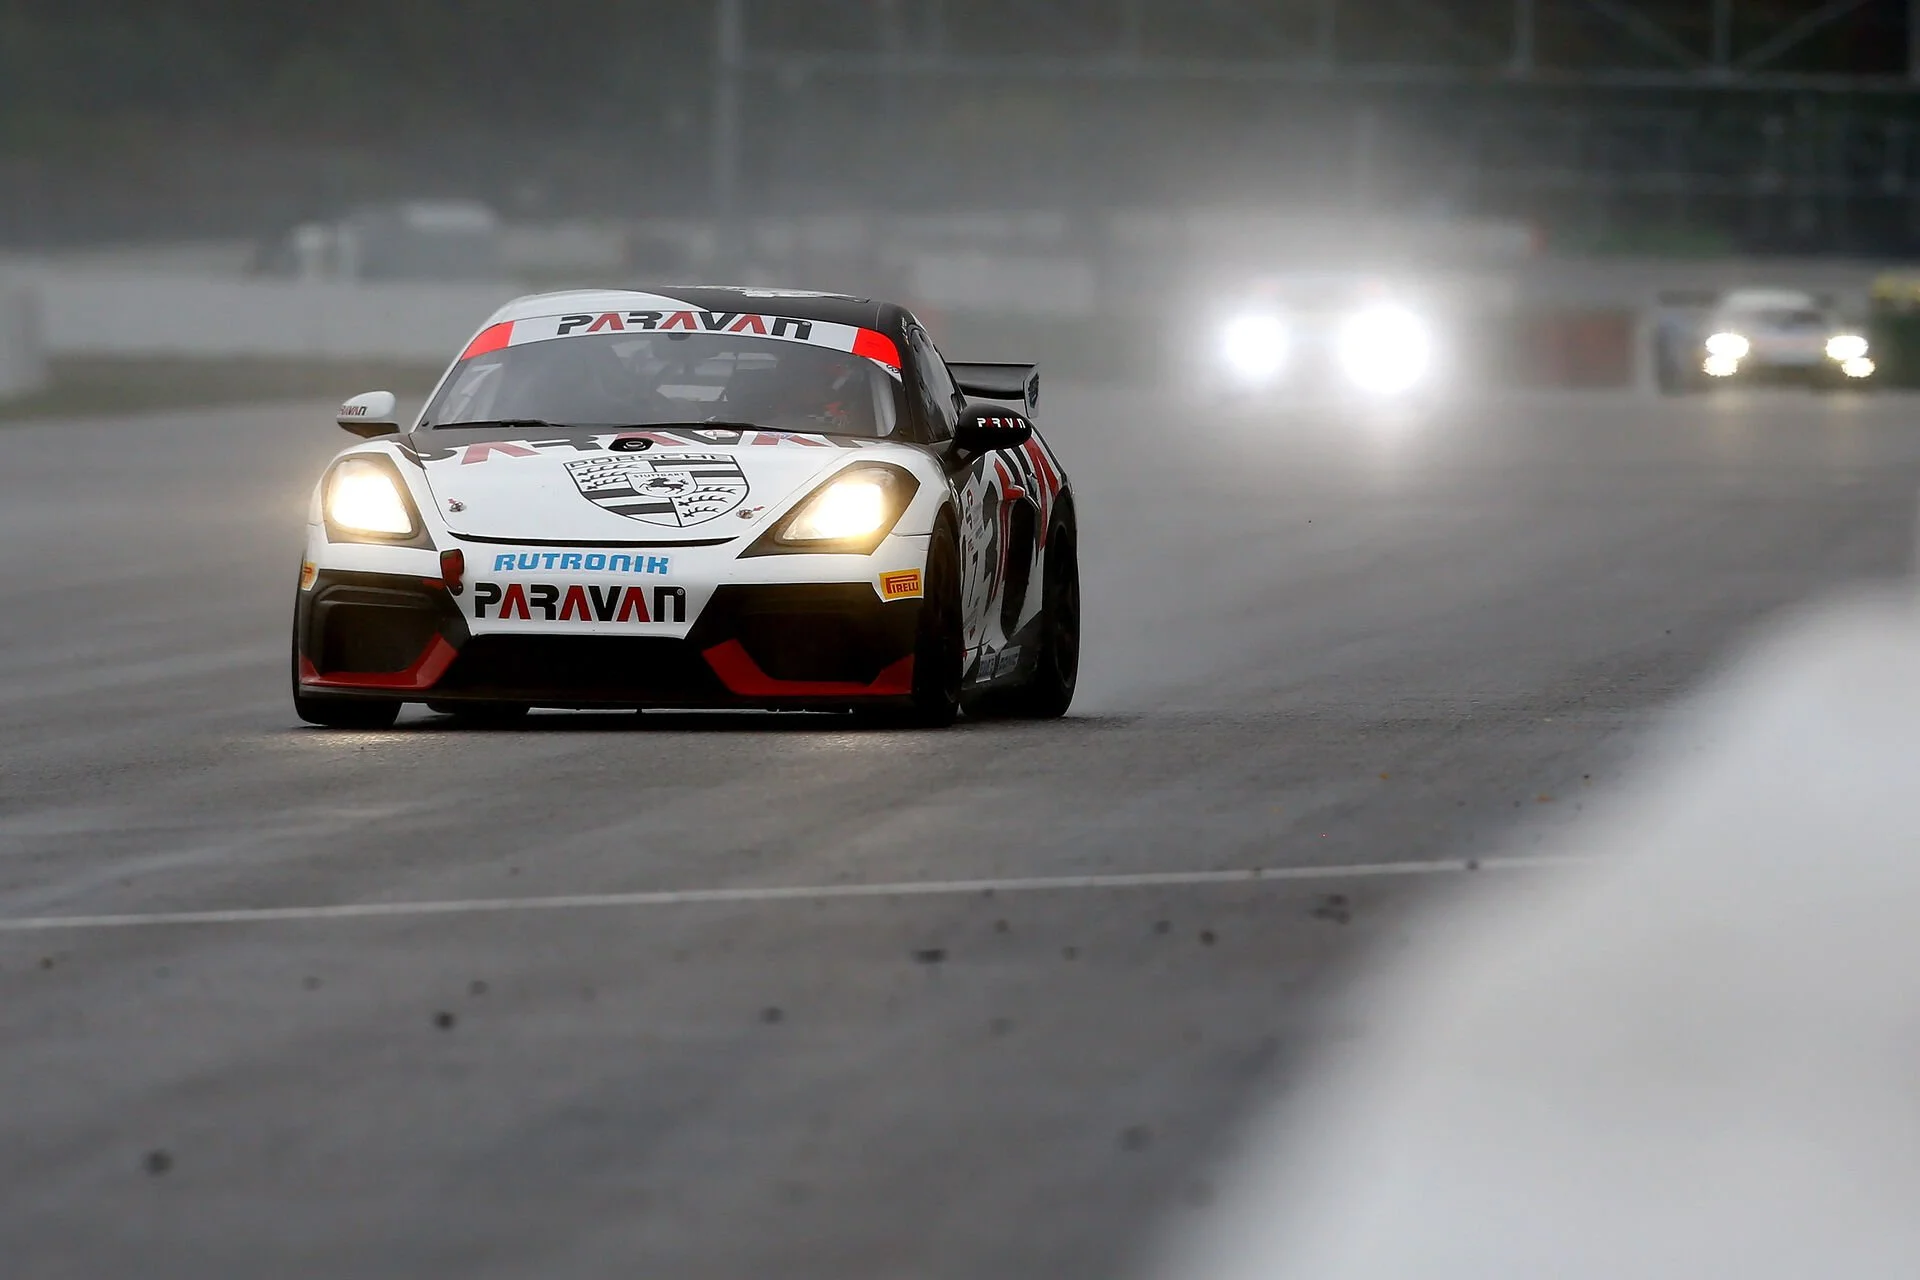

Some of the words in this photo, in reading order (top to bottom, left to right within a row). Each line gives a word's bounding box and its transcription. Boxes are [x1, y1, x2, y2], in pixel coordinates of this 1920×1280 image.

[556, 311, 812, 341] PARAVAN
[568, 452, 733, 468] PORSCHE
[493, 552, 669, 576] RUTRONIK
[884, 573, 920, 595] PIRELLI
[474, 582, 686, 623] PARAVAN
